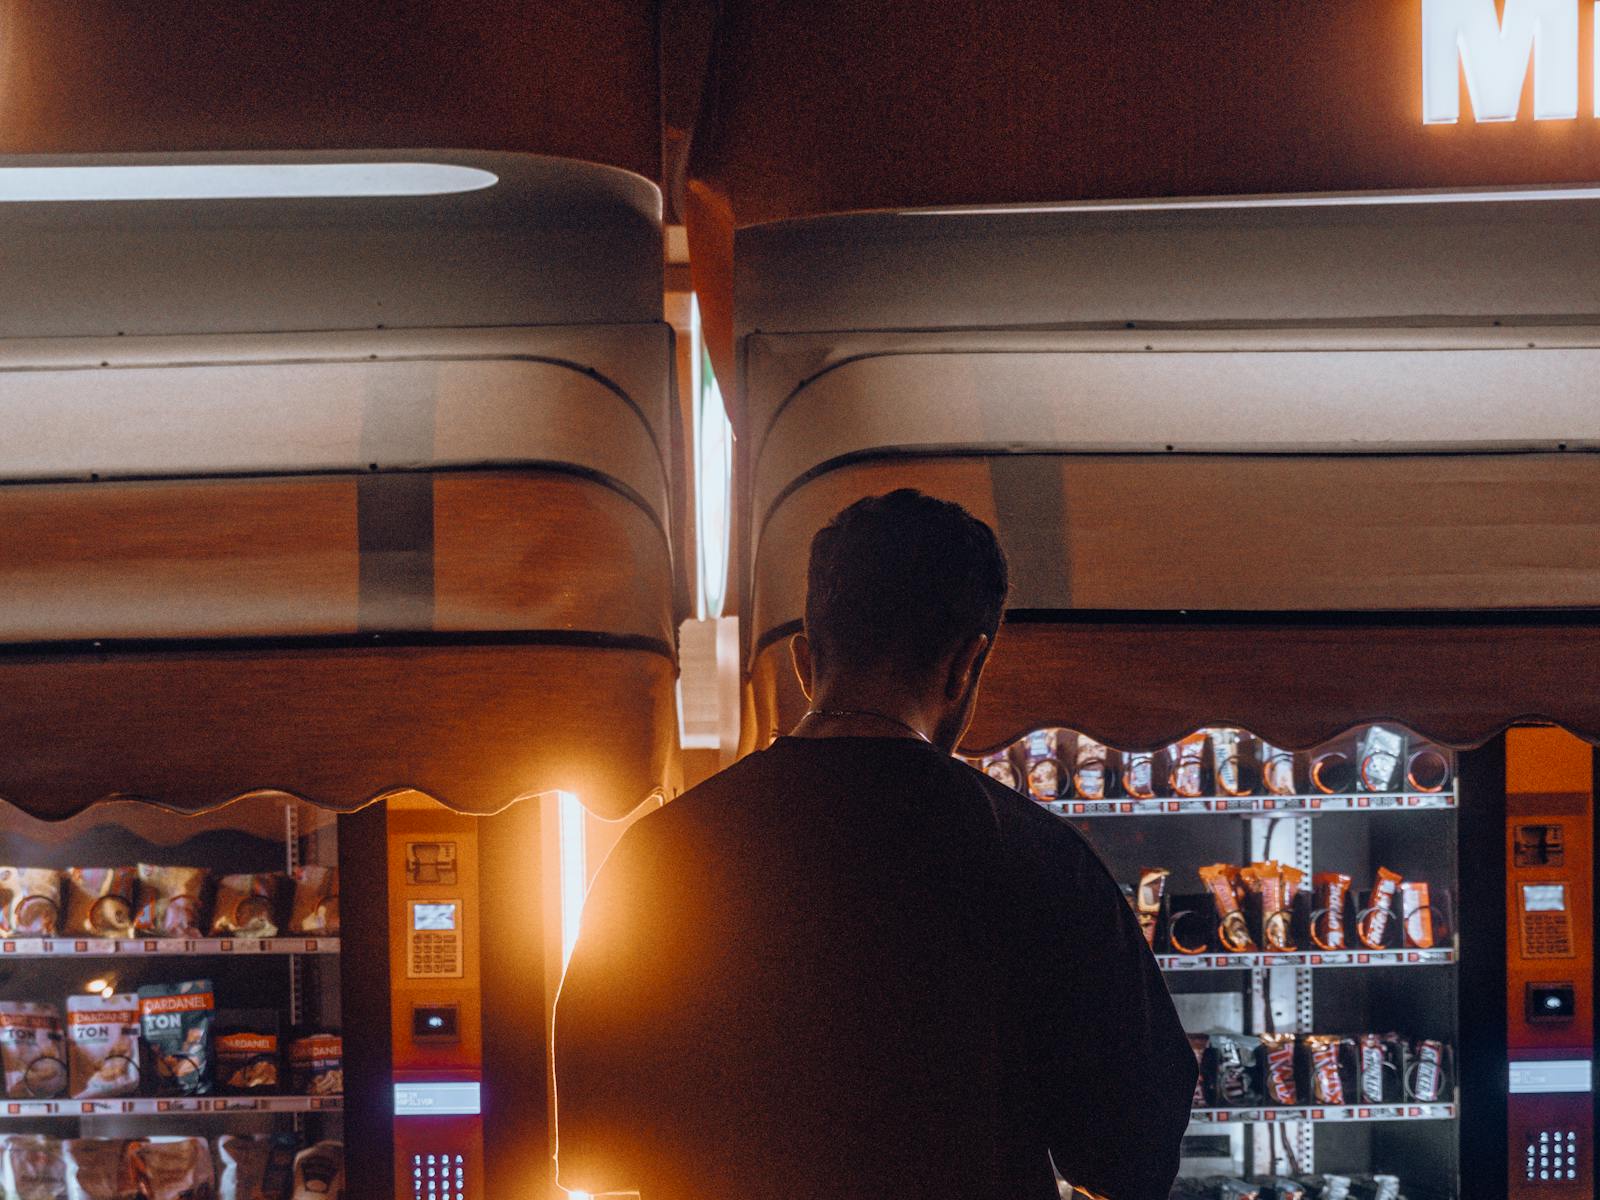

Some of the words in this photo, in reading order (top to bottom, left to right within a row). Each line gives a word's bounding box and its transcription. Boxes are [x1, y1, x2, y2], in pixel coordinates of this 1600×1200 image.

[144, 996, 207, 1011] DARDANEL
[145, 1013, 182, 1029] TON
[77, 1026, 109, 1038] TON
